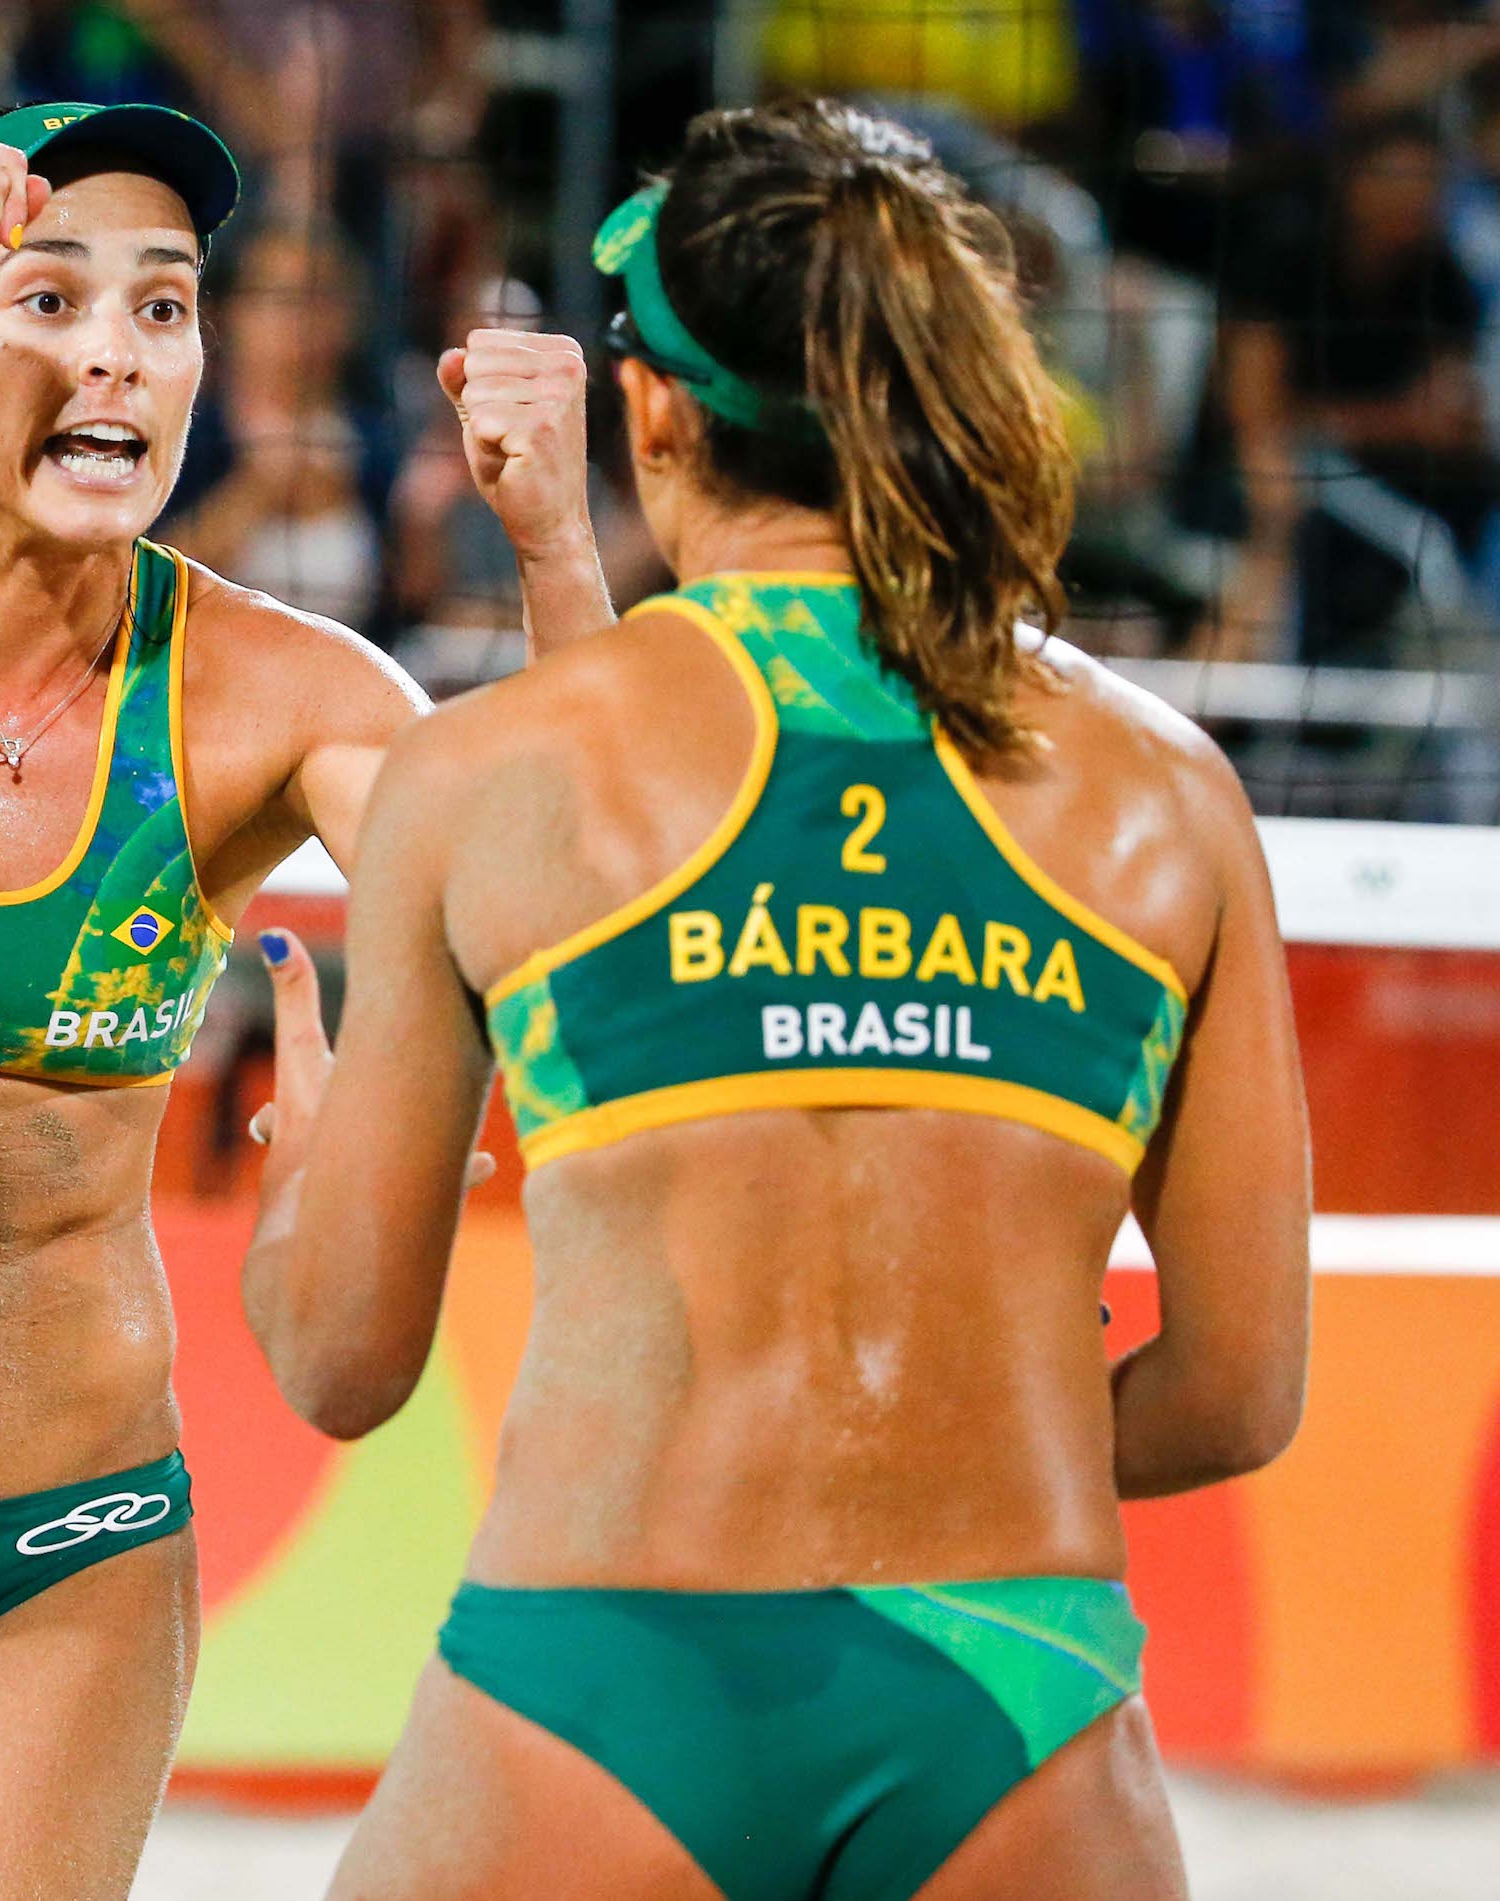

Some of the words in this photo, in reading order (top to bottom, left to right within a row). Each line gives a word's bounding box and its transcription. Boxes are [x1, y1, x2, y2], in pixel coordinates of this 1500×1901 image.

[839, 783, 887, 875] 2
[668, 882, 1085, 1013] BÁRBARA
[44, 988, 195, 1049] BRASIL
[761, 1002, 992, 1062] BRASIL
